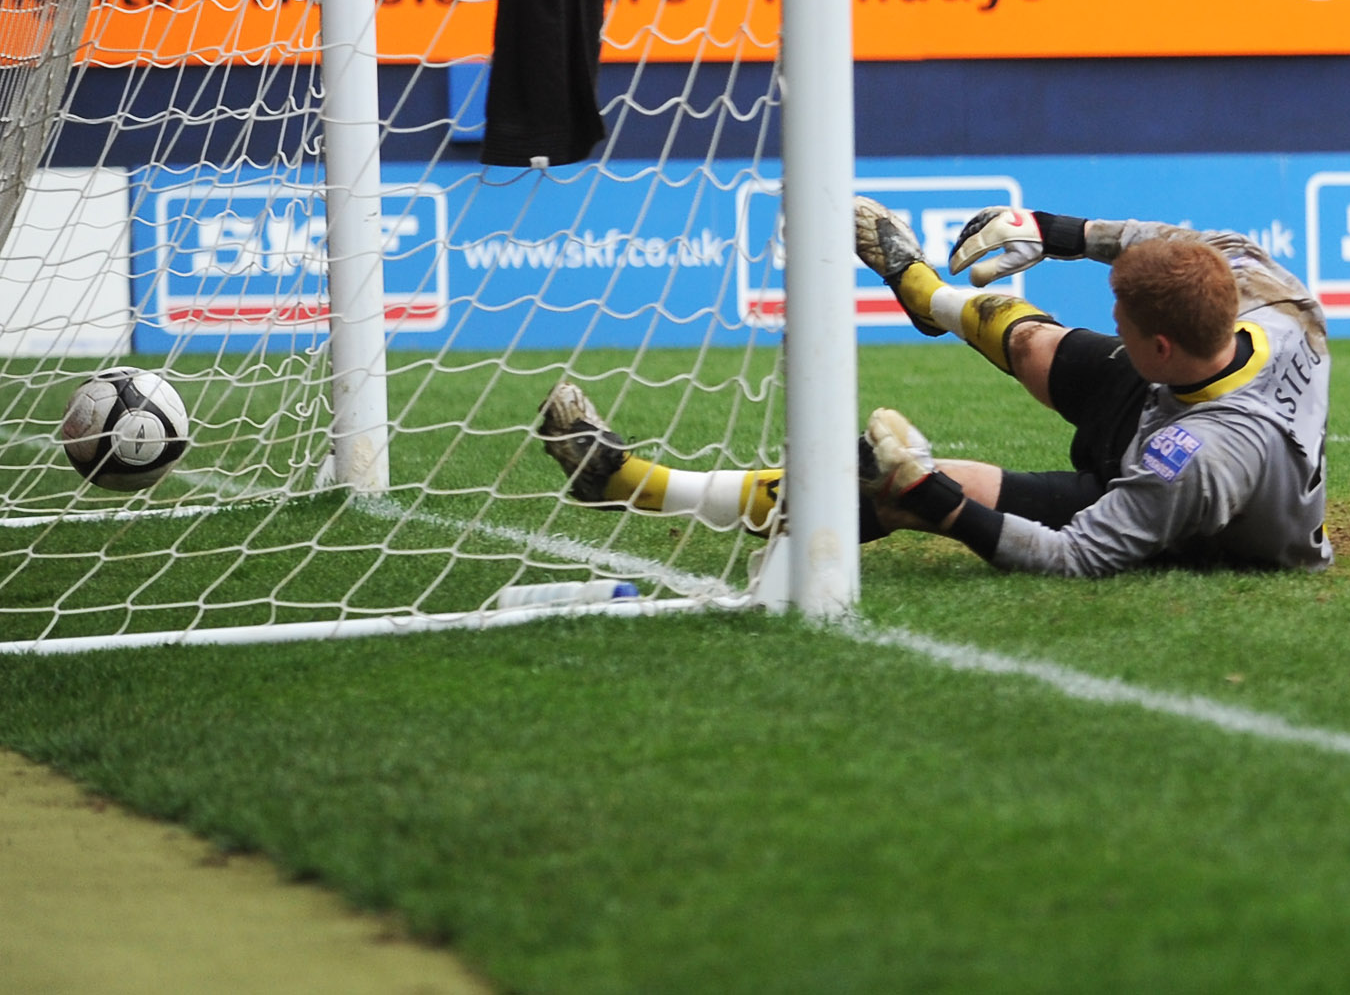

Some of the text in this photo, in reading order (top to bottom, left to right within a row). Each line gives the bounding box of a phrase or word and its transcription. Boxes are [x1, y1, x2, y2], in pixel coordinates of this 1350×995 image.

[463, 228, 725, 270] www.skf.co.uk
[1150, 436, 1176, 457] SQ
[1161, 425, 1200, 454] BLUE
